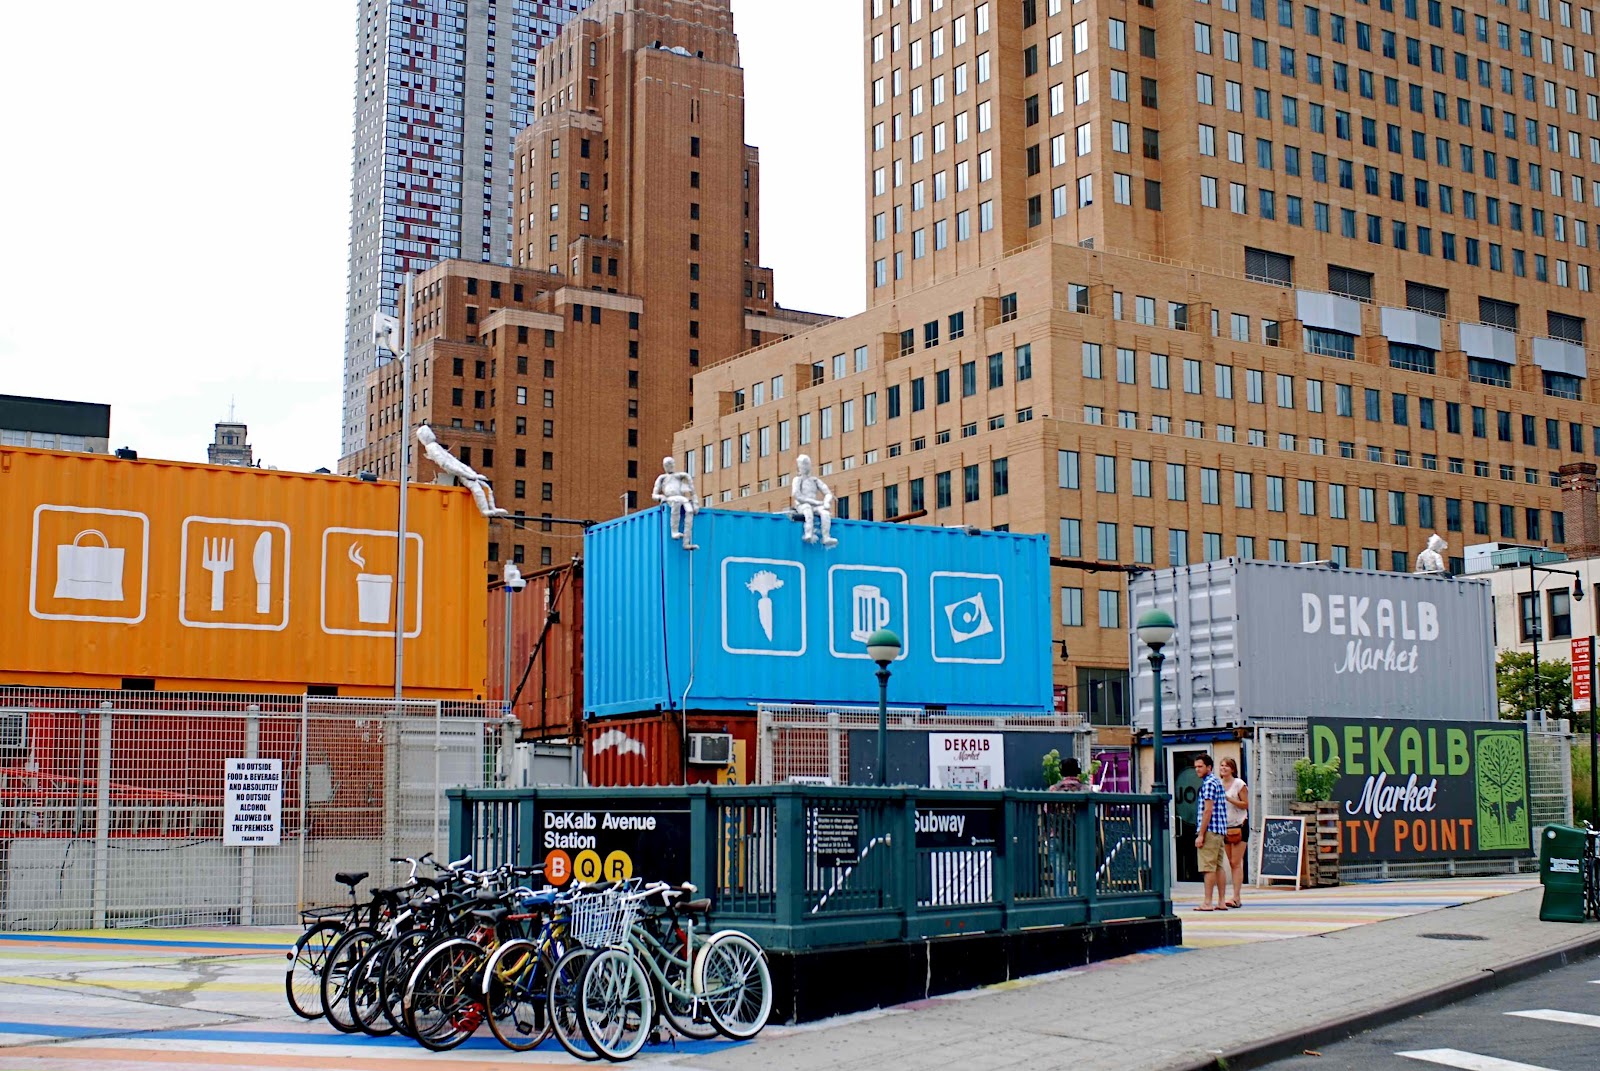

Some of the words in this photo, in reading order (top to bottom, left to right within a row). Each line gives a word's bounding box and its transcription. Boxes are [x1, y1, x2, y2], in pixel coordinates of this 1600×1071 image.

[1301, 592, 1440, 641] DEKALB
[1334, 638, 1418, 674] Market
[944, 738, 990, 751] DEKALB
[1312, 724, 1471, 776] DEKALB
[953, 750, 980, 762] Market
[236, 763, 245, 771] NO
[246, 763, 272, 771] OUTSIDE
[227, 773, 243, 781] FOOD
[249, 773, 279, 781] BEVERAGE
[229, 783, 242, 791] AND
[242, 783, 279, 791] ABSOLUTELY
[1176, 785, 1201, 805] JO
[1345, 771, 1438, 820] Market
[236, 793, 245, 801] NO
[246, 793, 271, 801] OUTSIDE
[240, 803, 267, 811] ALCOHOL
[234, 814, 262, 822] ALLOWED
[263, 814, 272, 822] ON
[544, 812, 597, 830] DeKalb
[601, 812, 657, 831] Avenue
[914, 810, 966, 838] Subway
[232, 824, 243, 832] THE
[244, 824, 274, 832] PREMISES
[1394, 818, 1473, 853] POINT
[544, 831, 596, 849] Station
[552, 857, 565, 878] B
[581, 858, 595, 878] Q
[612, 859, 625, 878] R
